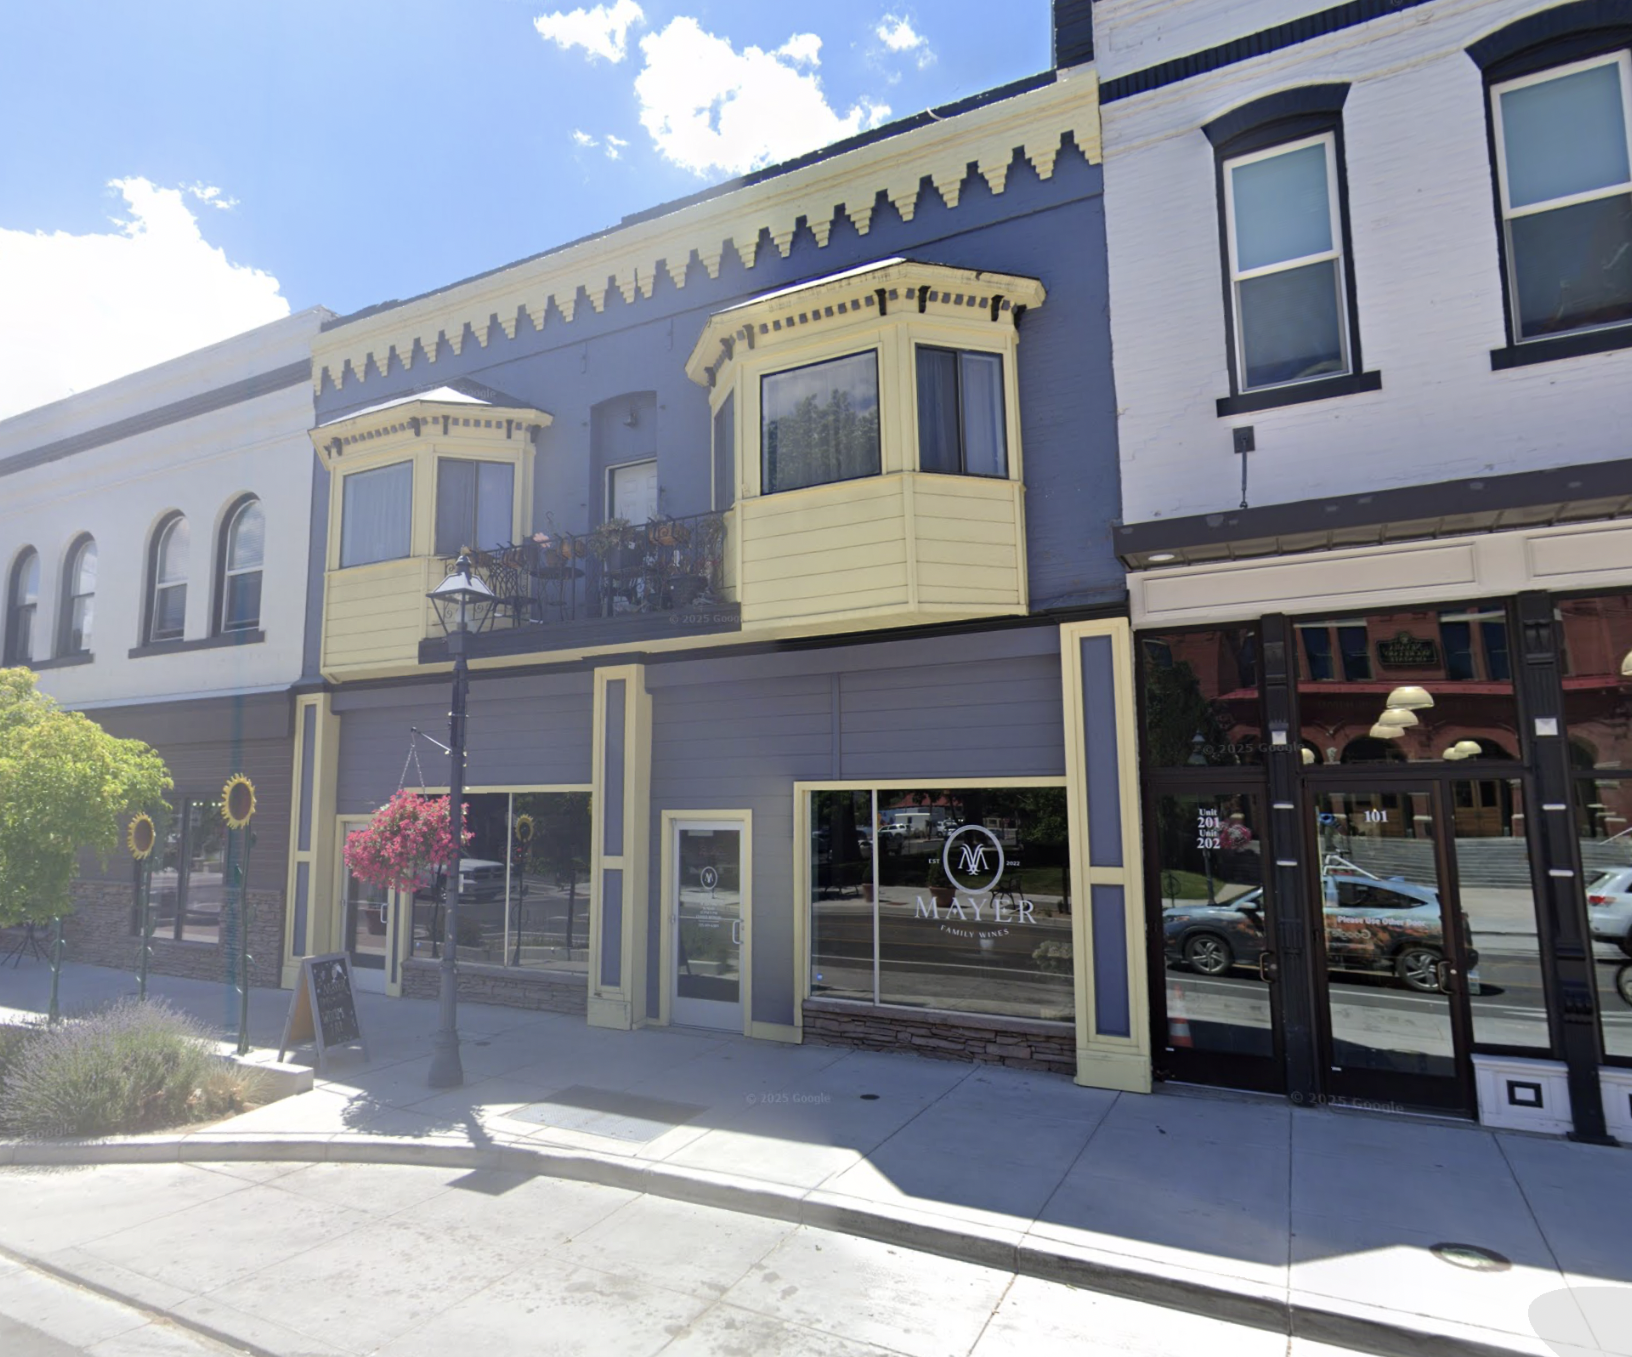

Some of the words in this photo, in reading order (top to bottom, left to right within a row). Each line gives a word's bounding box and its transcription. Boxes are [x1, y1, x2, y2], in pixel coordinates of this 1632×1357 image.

[1199, 808, 1217, 816] Unit
[1364, 810, 1389, 823] 101
[1197, 817, 1220, 828] 201
[1199, 829, 1217, 837] Unit
[1197, 838, 1221, 849] 202
[914, 896, 1037, 924] MAYER
[941, 924, 975, 938] FAMILY
[978, 928, 1010, 938] WINES
